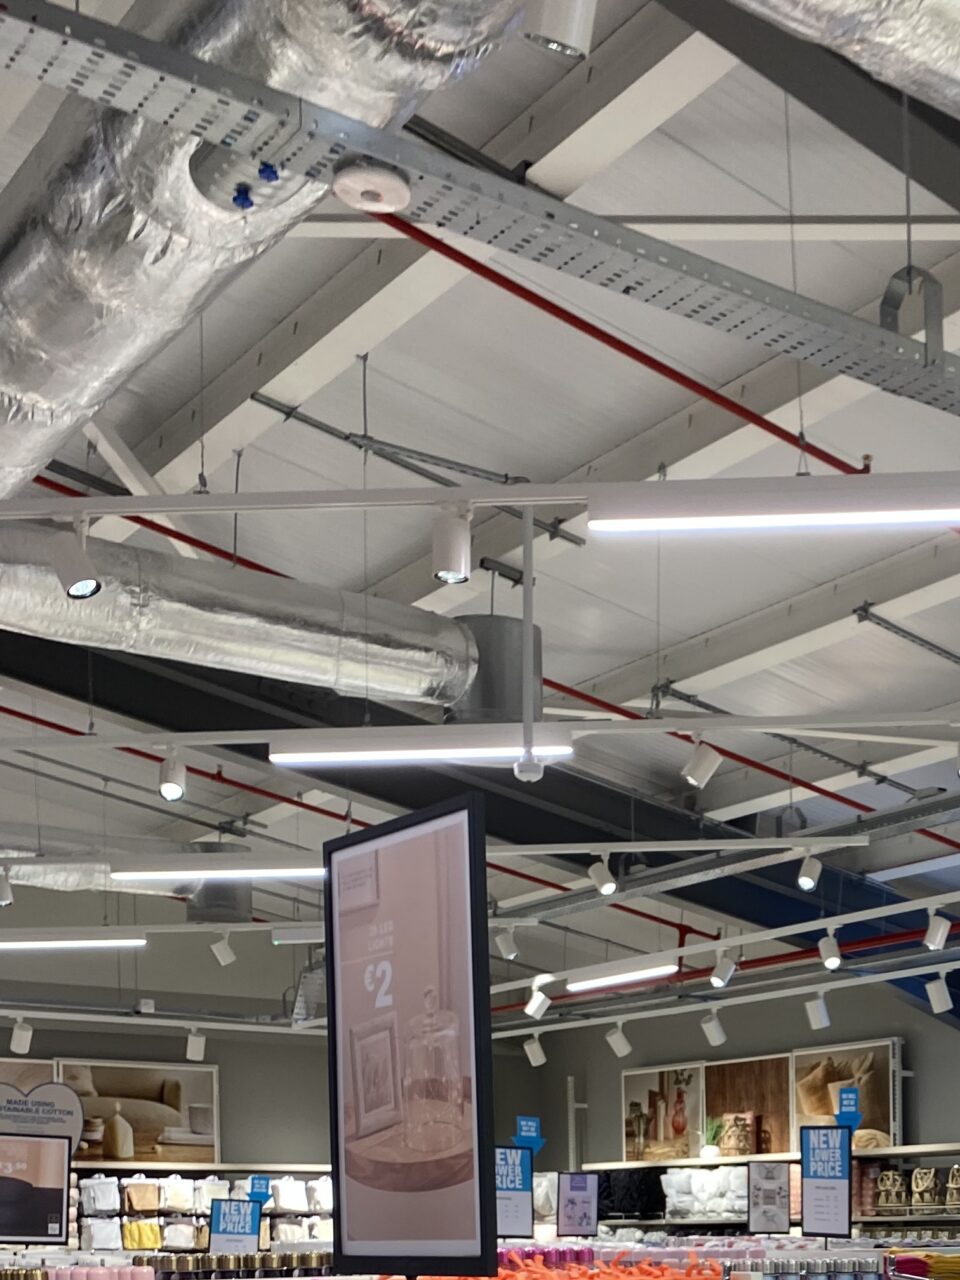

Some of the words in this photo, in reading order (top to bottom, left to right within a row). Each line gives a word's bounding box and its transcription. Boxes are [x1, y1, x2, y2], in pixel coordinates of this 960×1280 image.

[364, 960, 393, 1008] €2
[809, 1129, 841, 1148] NEW
[495, 1149, 522, 1165] EW
[809, 1149, 842, 1161] LOWER
[809, 1162, 842, 1177] PRICE
[496, 1176, 523, 1189] RICE
[221, 1201, 253, 1215] NEW
